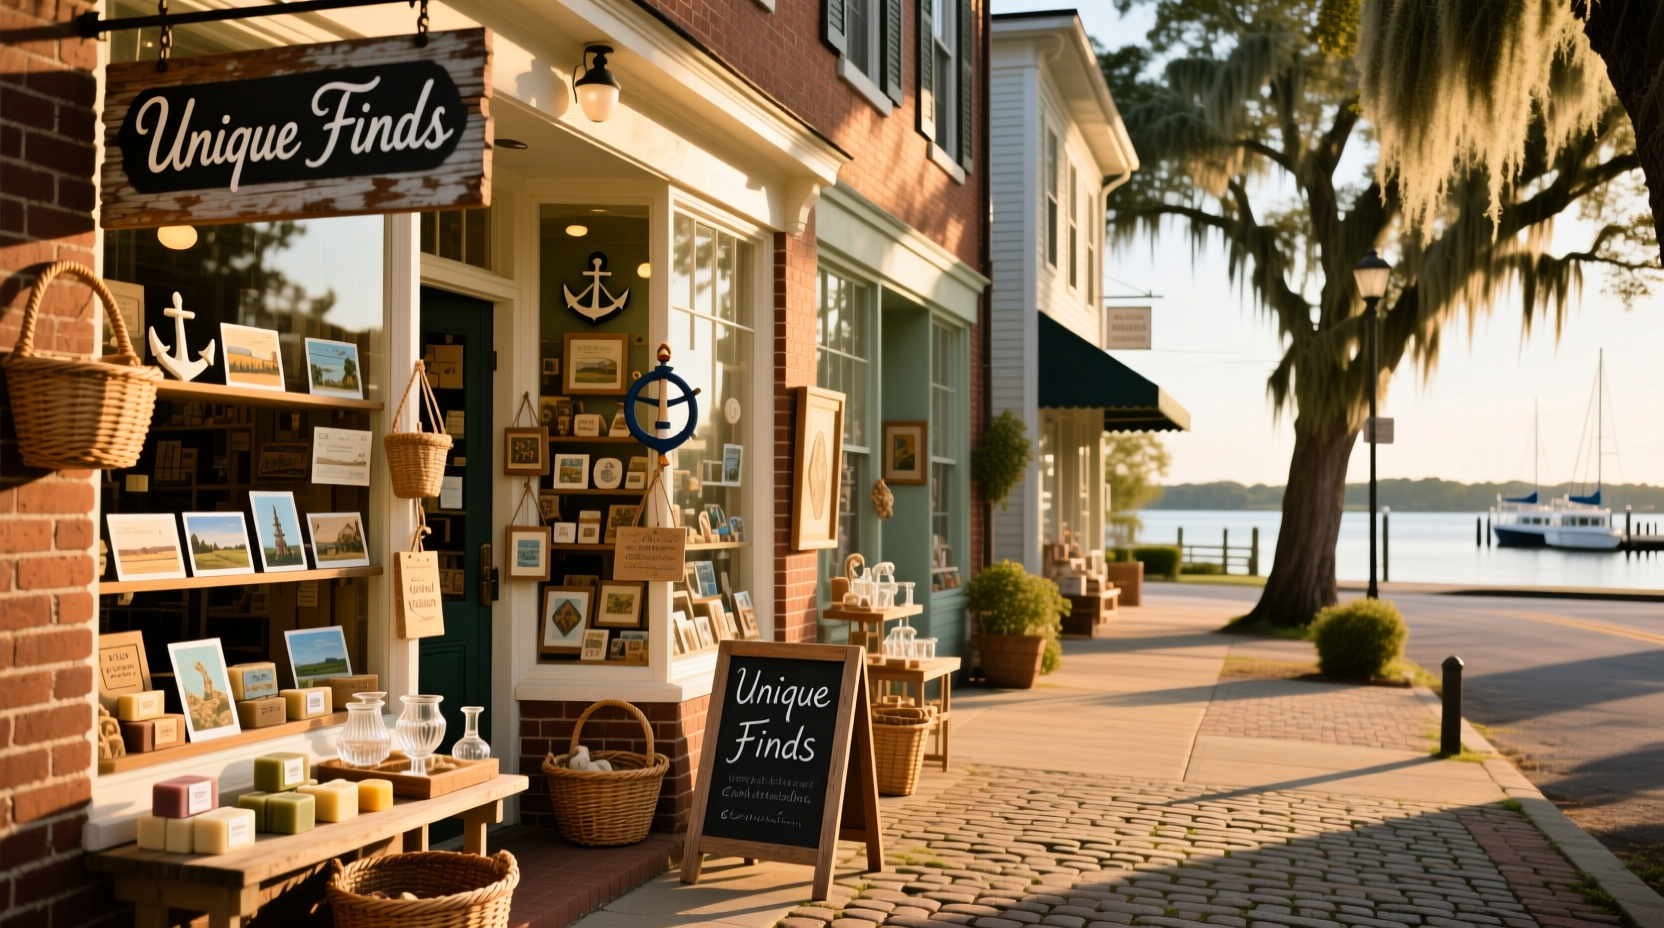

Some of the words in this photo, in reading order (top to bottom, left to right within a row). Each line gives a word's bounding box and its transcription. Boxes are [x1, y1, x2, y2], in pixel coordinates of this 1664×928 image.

[135, 95, 302, 193] Unique
[305, 75, 454, 169] Finds
[736, 667, 831, 723] Unique
[725, 718, 816, 764] Finds
